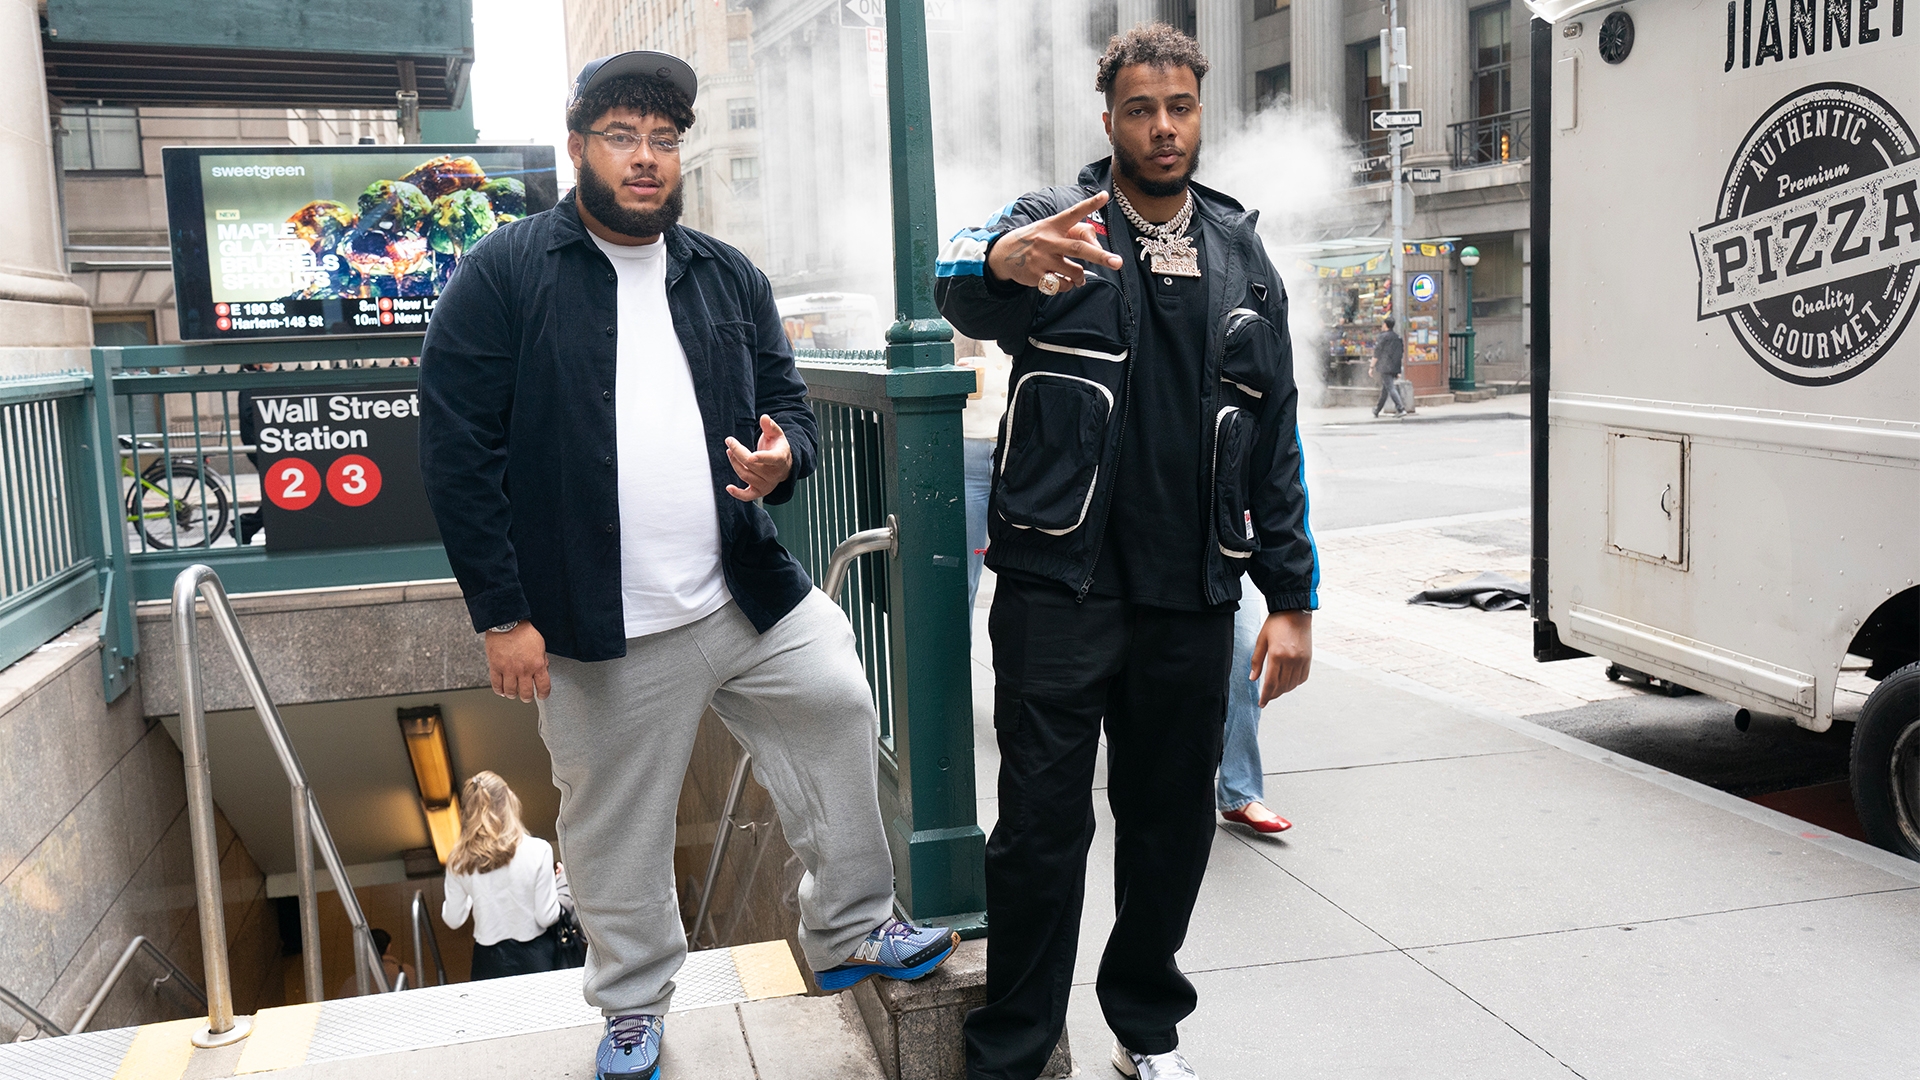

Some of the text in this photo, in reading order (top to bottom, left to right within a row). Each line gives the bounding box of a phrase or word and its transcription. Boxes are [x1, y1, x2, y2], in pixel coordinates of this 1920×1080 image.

[860, 0, 882, 15] ON
[1380, 116, 1394, 124] ONE
[1750, 109, 1867, 182] AUTHENTIC
[212, 165, 305, 179] sweetgreen
[1351, 161, 1372, 173] WALL
[1777, 163, 1850, 198] Premium
[217, 222, 297, 240] MAPLE
[1713, 180, 1920, 295] PIZZA
[219, 239, 312, 257] GLAZED
[220, 253, 340, 273] BRUSSELS
[222, 270, 331, 290] SPROUTS
[230, 304, 241, 316] E
[244, 303, 268, 315] 180
[269, 302, 285, 314] St
[393, 298, 421, 311] New
[1792, 286, 1855, 318] Quality
[232, 315, 306, 330] Harlem-148
[308, 314, 324, 327] St
[353, 313, 378, 325] 10m
[394, 311, 422, 324] New
[1772, 301, 1881, 359] GOURMET
[257, 394, 420, 424] Wall Street
[260, 425, 368, 453] Station
[281, 464, 367, 498] 2 3
